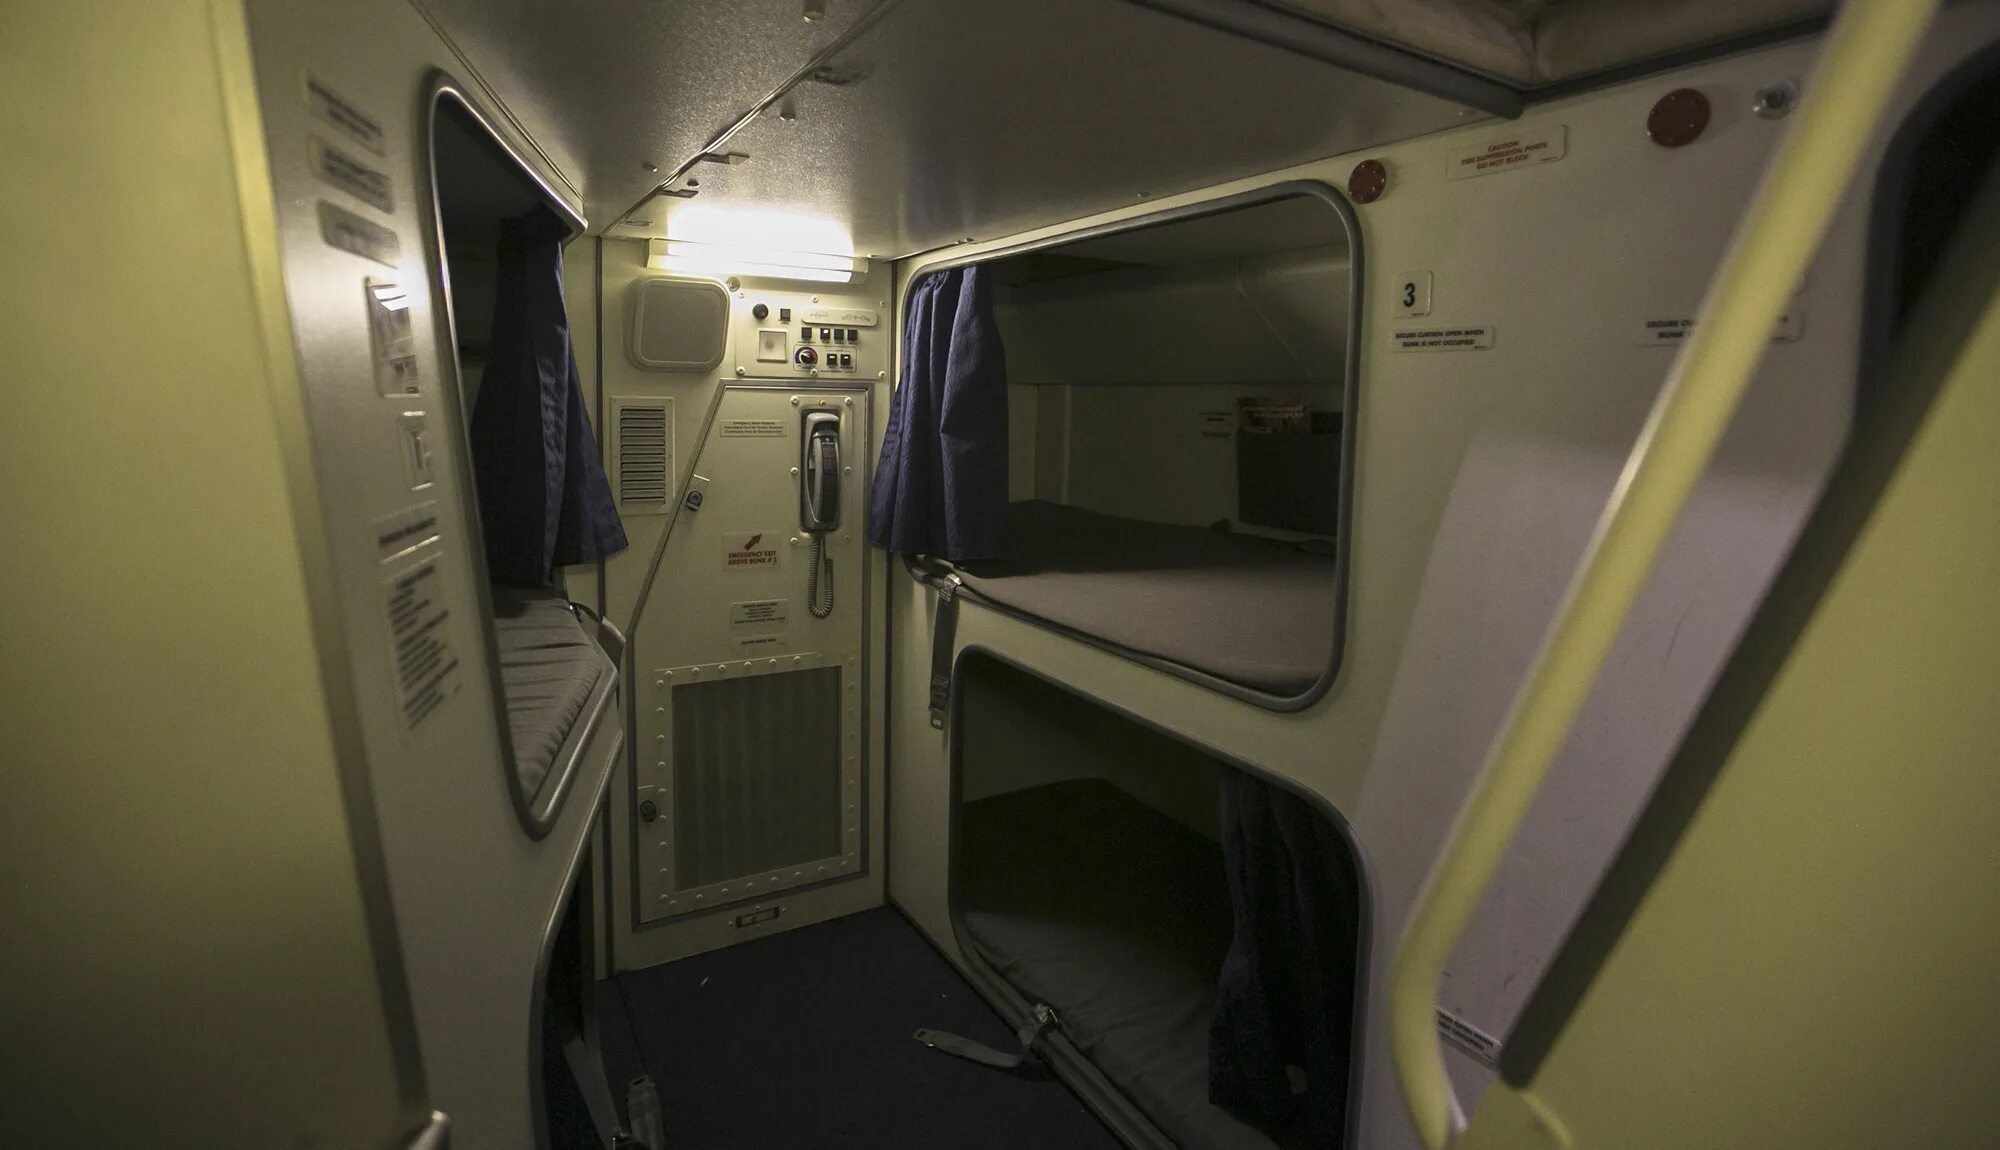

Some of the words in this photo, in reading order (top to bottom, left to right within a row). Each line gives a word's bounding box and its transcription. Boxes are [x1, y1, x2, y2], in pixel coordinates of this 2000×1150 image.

[1488, 141, 1520, 152] CAUTION
[1489, 158, 1505, 167] NOT
[1506, 154, 1529, 164] BLOCK
[1403, 282, 1416, 308] 3
[1464, 328, 1485, 337] WHEN
[1443, 338, 1476, 346] OCCUPIED
[728, 551, 763, 559] EMERGENCY
